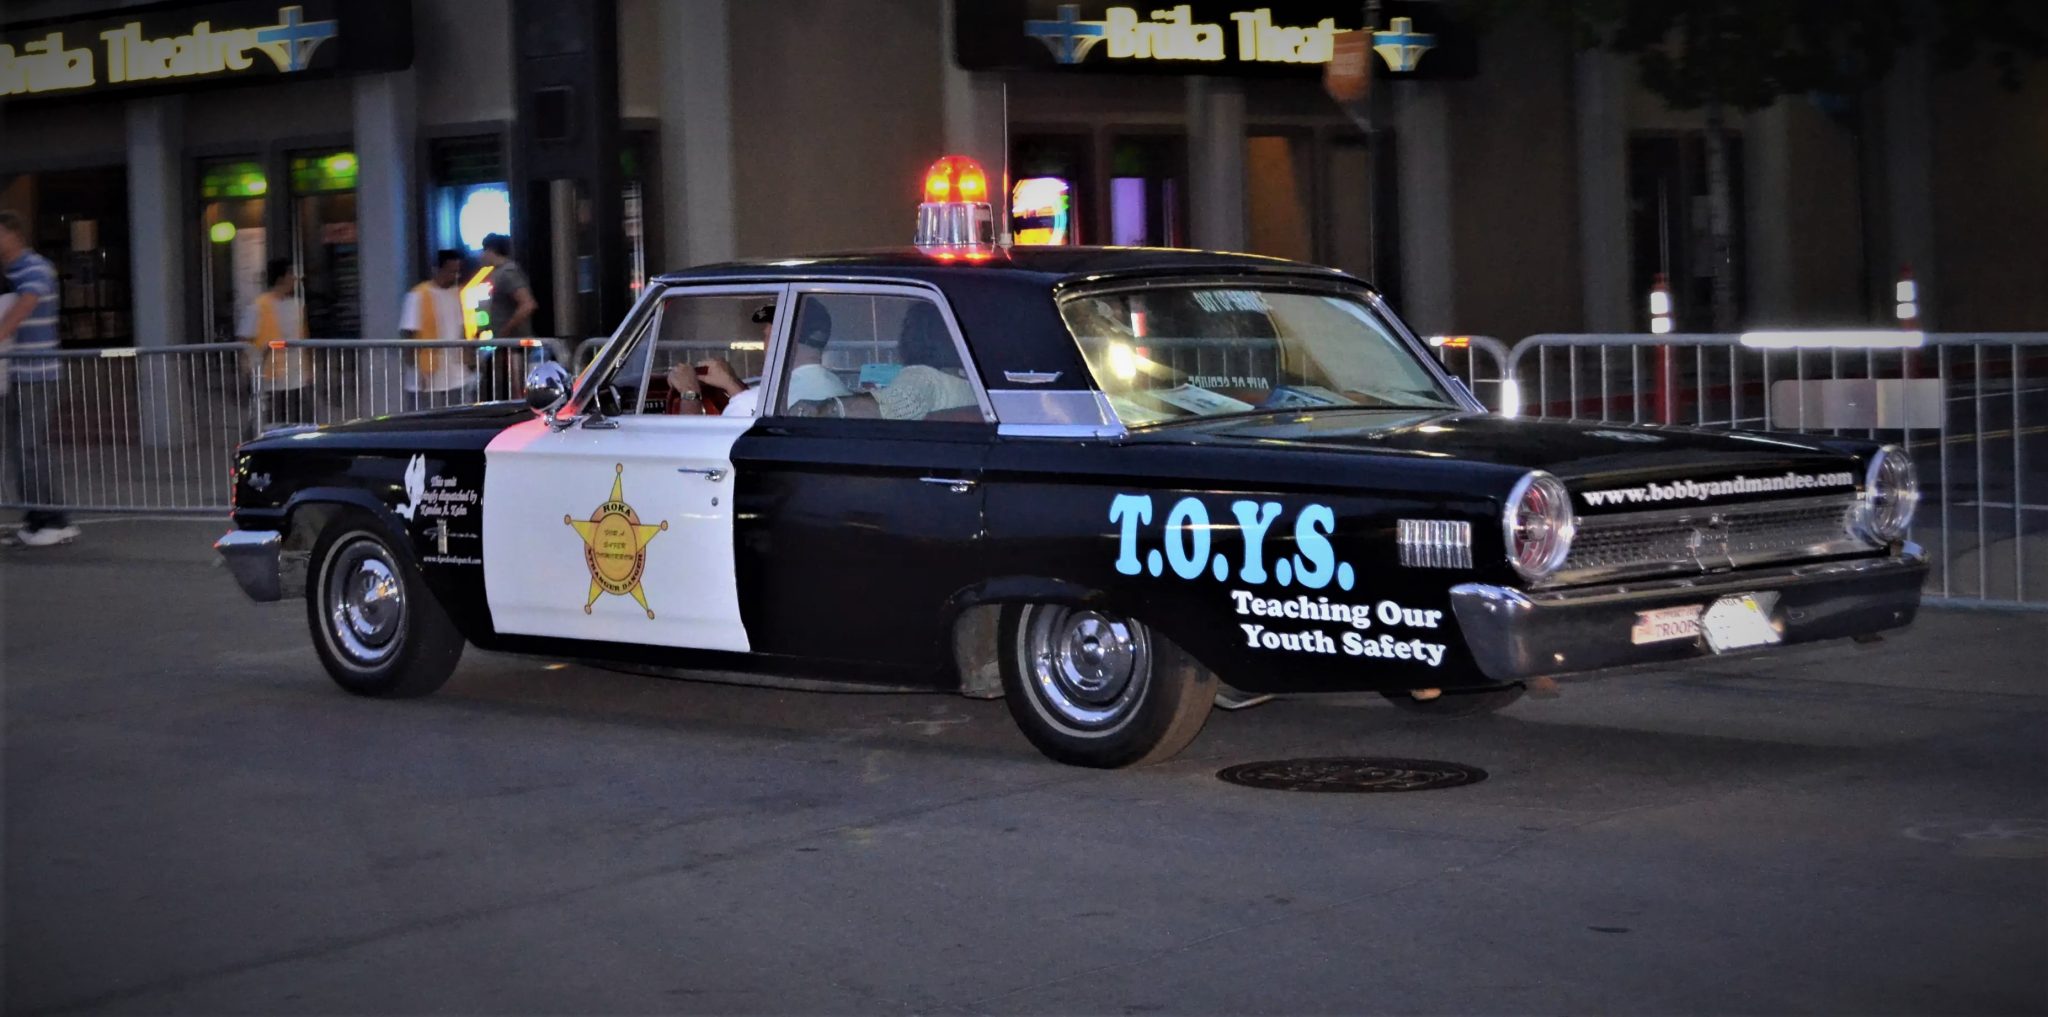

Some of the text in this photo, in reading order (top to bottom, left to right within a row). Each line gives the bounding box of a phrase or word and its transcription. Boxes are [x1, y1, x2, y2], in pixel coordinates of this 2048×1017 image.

[100, 21, 254, 83] Theatre
[1231, 8, 1352, 63] Theat
[1581, 472, 1853, 507] www.bobbyandmandee.com
[1109, 493, 1356, 591] T.O.Y.S.
[622, 553, 643, 590] DANGER
[1231, 589, 1443, 629] Teaching Our
[1655, 620, 1701, 638] TROOPS
[1240, 623, 1447, 667] Youth Safety
